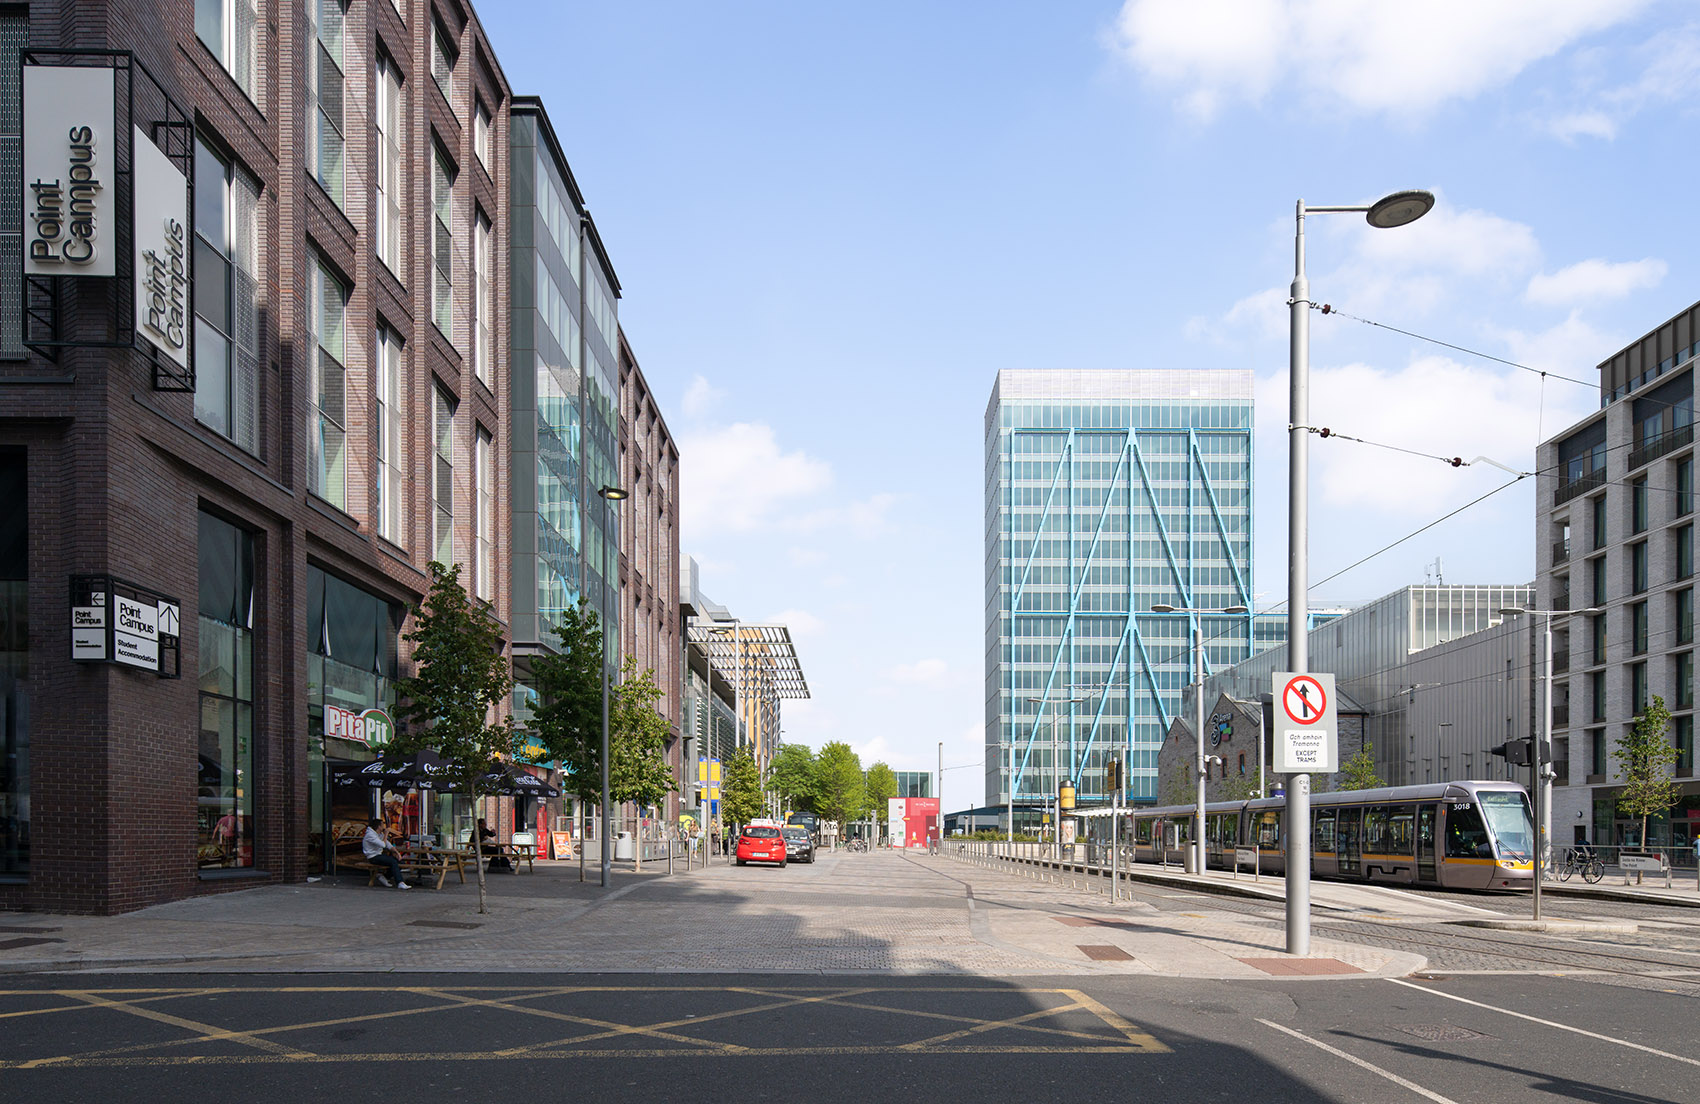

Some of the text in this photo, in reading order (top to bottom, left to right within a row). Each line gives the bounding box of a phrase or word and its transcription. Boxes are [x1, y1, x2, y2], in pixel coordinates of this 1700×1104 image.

[62, 125, 99, 263] Campus
[30, 178, 61, 262] Point
[146, 249, 167, 337] Point
[165, 217, 186, 349] Campus
[75, 617, 102, 625] Campus
[120, 603, 142, 619] Point
[120, 615, 155, 633] Campus
[118, 640, 138, 650] Student
[118, 649, 157, 663] Accommodation
[329, 708, 388, 744] Pita Pit
